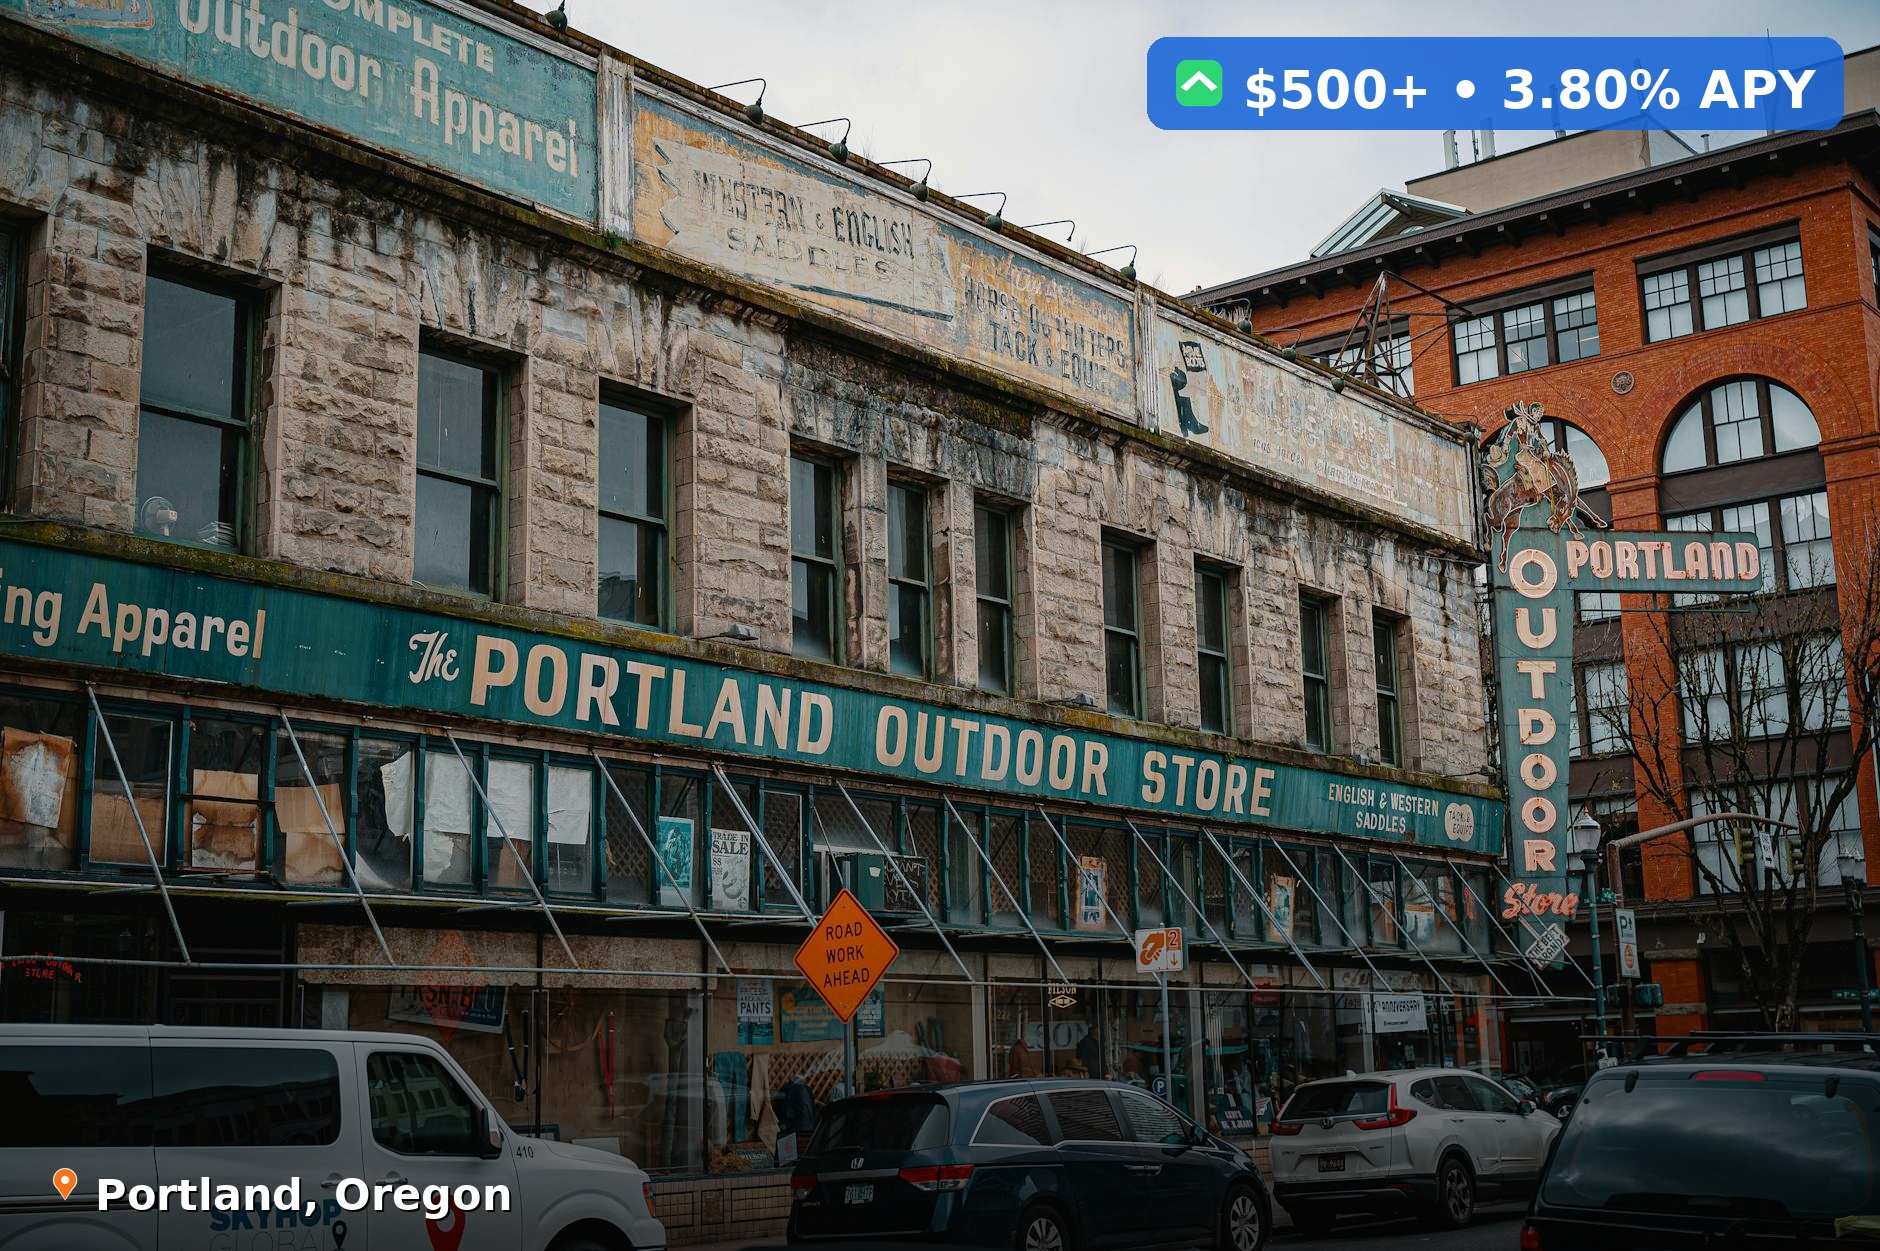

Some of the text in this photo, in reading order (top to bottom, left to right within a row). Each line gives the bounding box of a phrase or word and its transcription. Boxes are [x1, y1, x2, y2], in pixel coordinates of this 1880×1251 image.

[409, 54, 579, 179] Apparel
[831, 205, 915, 260] ENGLISH
[988, 320, 1039, 367] TACK
[1567, 540, 1760, 581] PORTLAND
[0, 567, 266, 660] ng Apparel
[1508, 548, 1558, 872] OUTDOOR
[408, 630, 1275, 817] The PORTLAND OUTDOOR STORE
[1328, 783, 1439, 817] ENGLISH & WESTERN
[1355, 810, 1407, 834] SADDLES
[712, 831, 749, 843] TRADE IN
[712, 840, 749, 856] SALE
[1502, 882, 1580, 920] Store
[825, 921, 863, 942] ROAD
[1168, 931, 1178, 948] 2
[1541, 926, 1559, 947] BET
[826, 944, 865, 965] WORK
[823, 967, 870, 989] AHEAD
[740, 1001, 771, 1014] PANTS
[515, 1145, 535, 1160] 410
